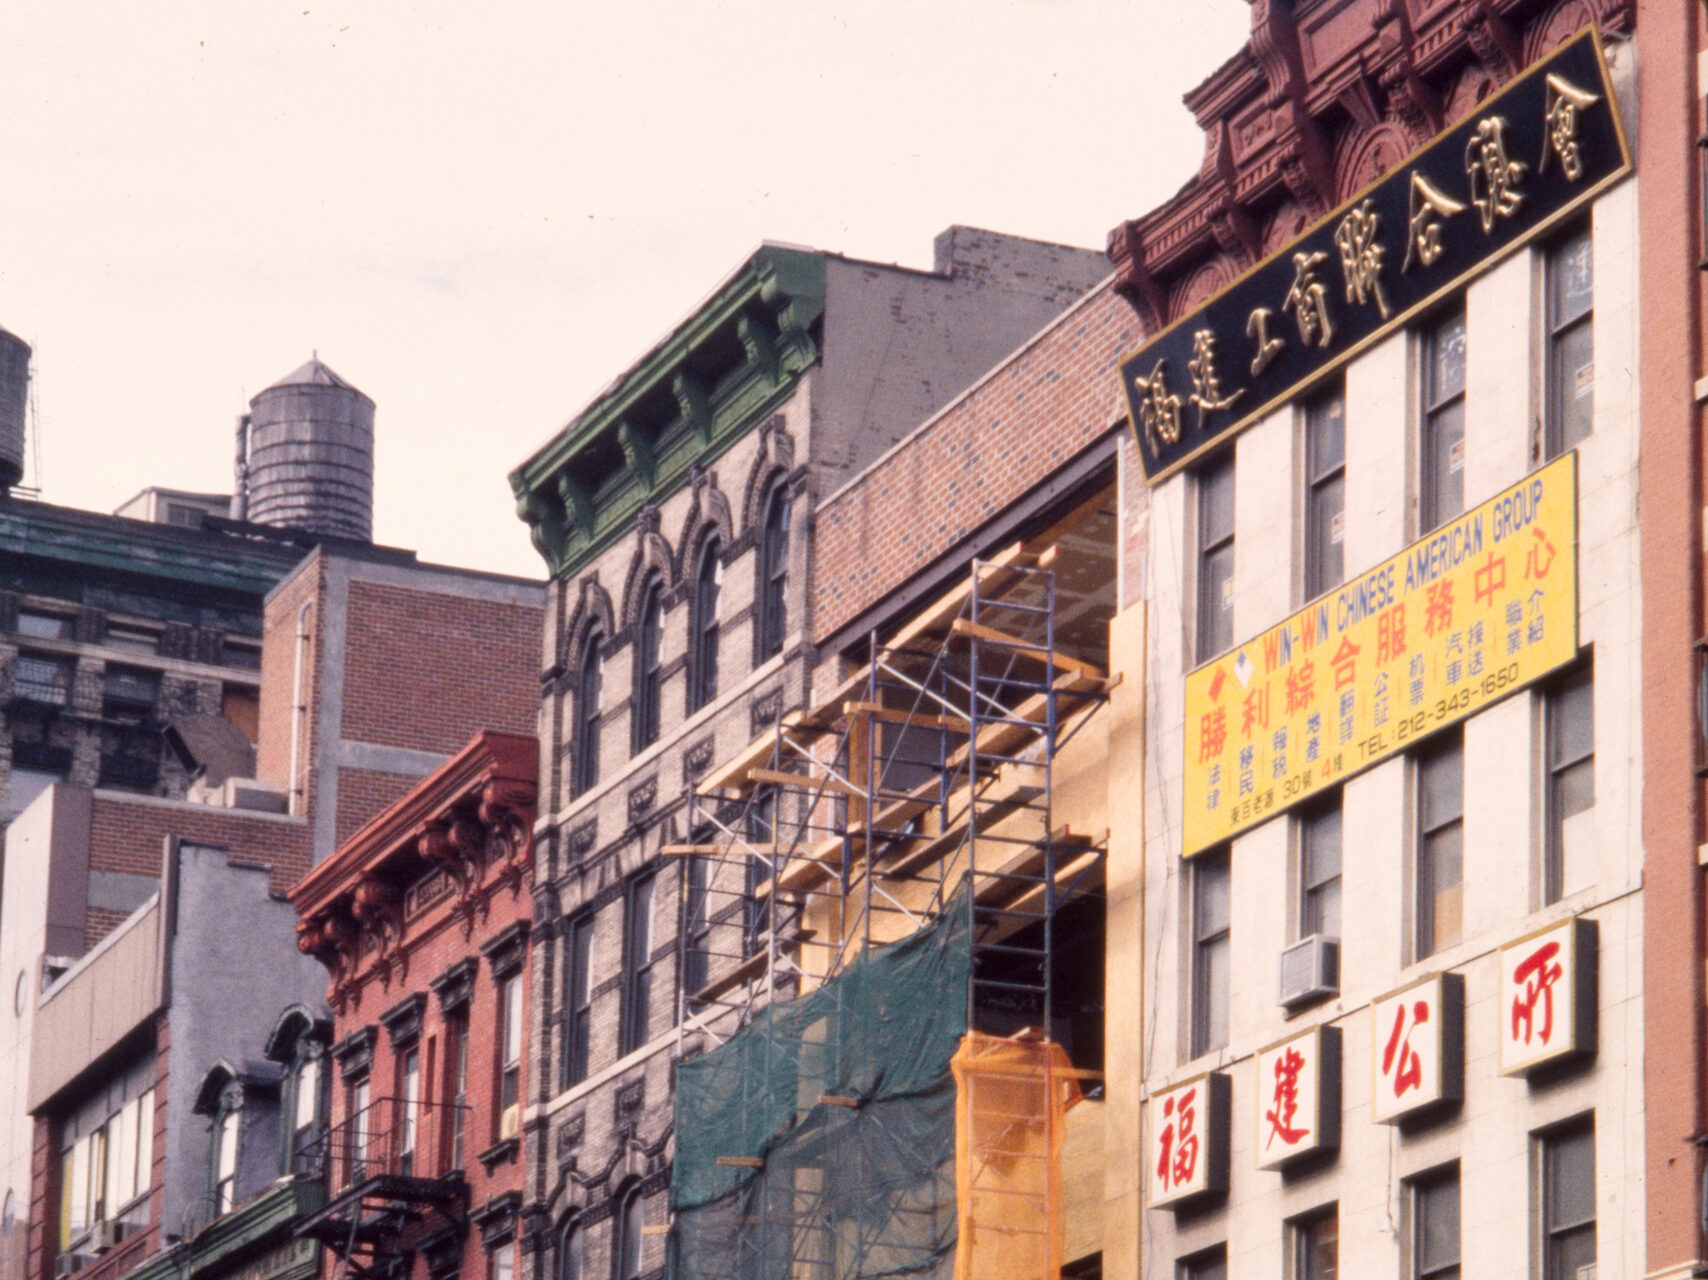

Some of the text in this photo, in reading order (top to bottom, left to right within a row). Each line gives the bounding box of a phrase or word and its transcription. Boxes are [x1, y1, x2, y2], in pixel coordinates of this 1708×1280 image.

[1199, 527, 1556, 765] 勝利綜合服務中心
[1263, 479, 1543, 675] WIN-WIN CHINESE AMERICAN GROUP
[1397, 661, 1519, 741] 212-343-1650
